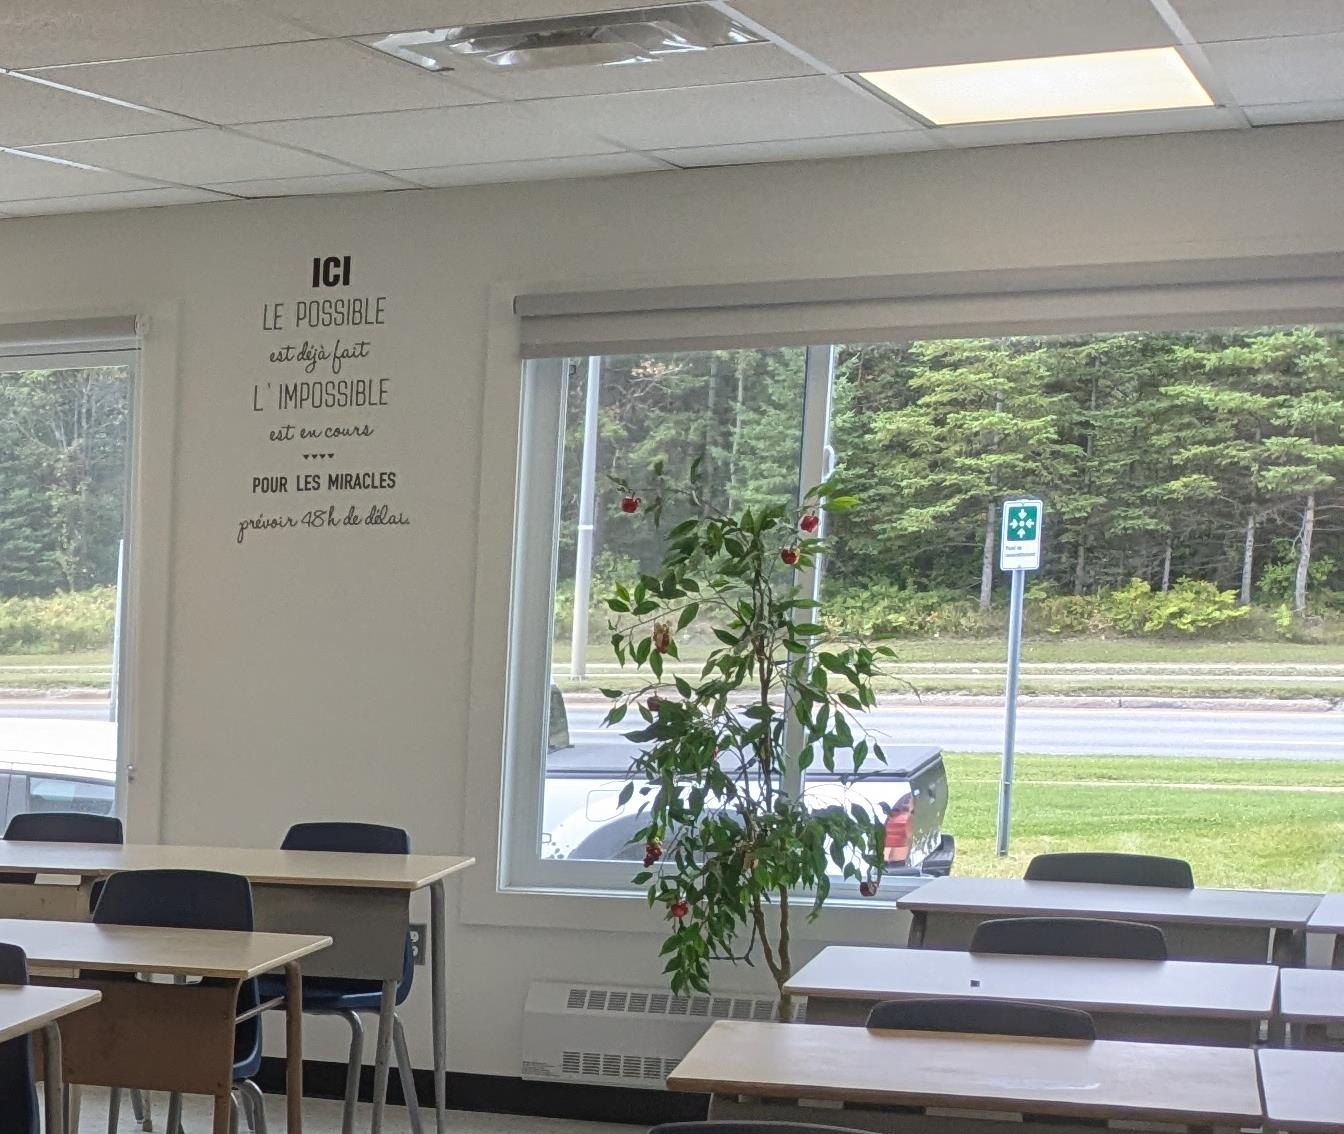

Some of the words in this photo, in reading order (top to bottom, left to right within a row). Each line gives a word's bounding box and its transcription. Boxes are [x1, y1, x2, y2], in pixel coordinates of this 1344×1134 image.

[312, 256, 351, 288] ICI
[263, 303, 284, 330] LE
[295, 297, 387, 328] POSSIBLE
[269, 345, 295, 363] est
[297, 341, 331, 374] déjà
[332, 339, 372, 374] fait
[269, 424, 295, 442] est
[300, 427, 323, 440] en
[324, 423, 375, 439] cours
[252, 476, 288, 494] POUR
[296, 474, 321, 492] LES
[327, 472, 397, 491] MIRACLES
[237, 510, 298, 544] prévoir
[300, 508, 341, 528] 48h
[342, 507, 363, 526] de
